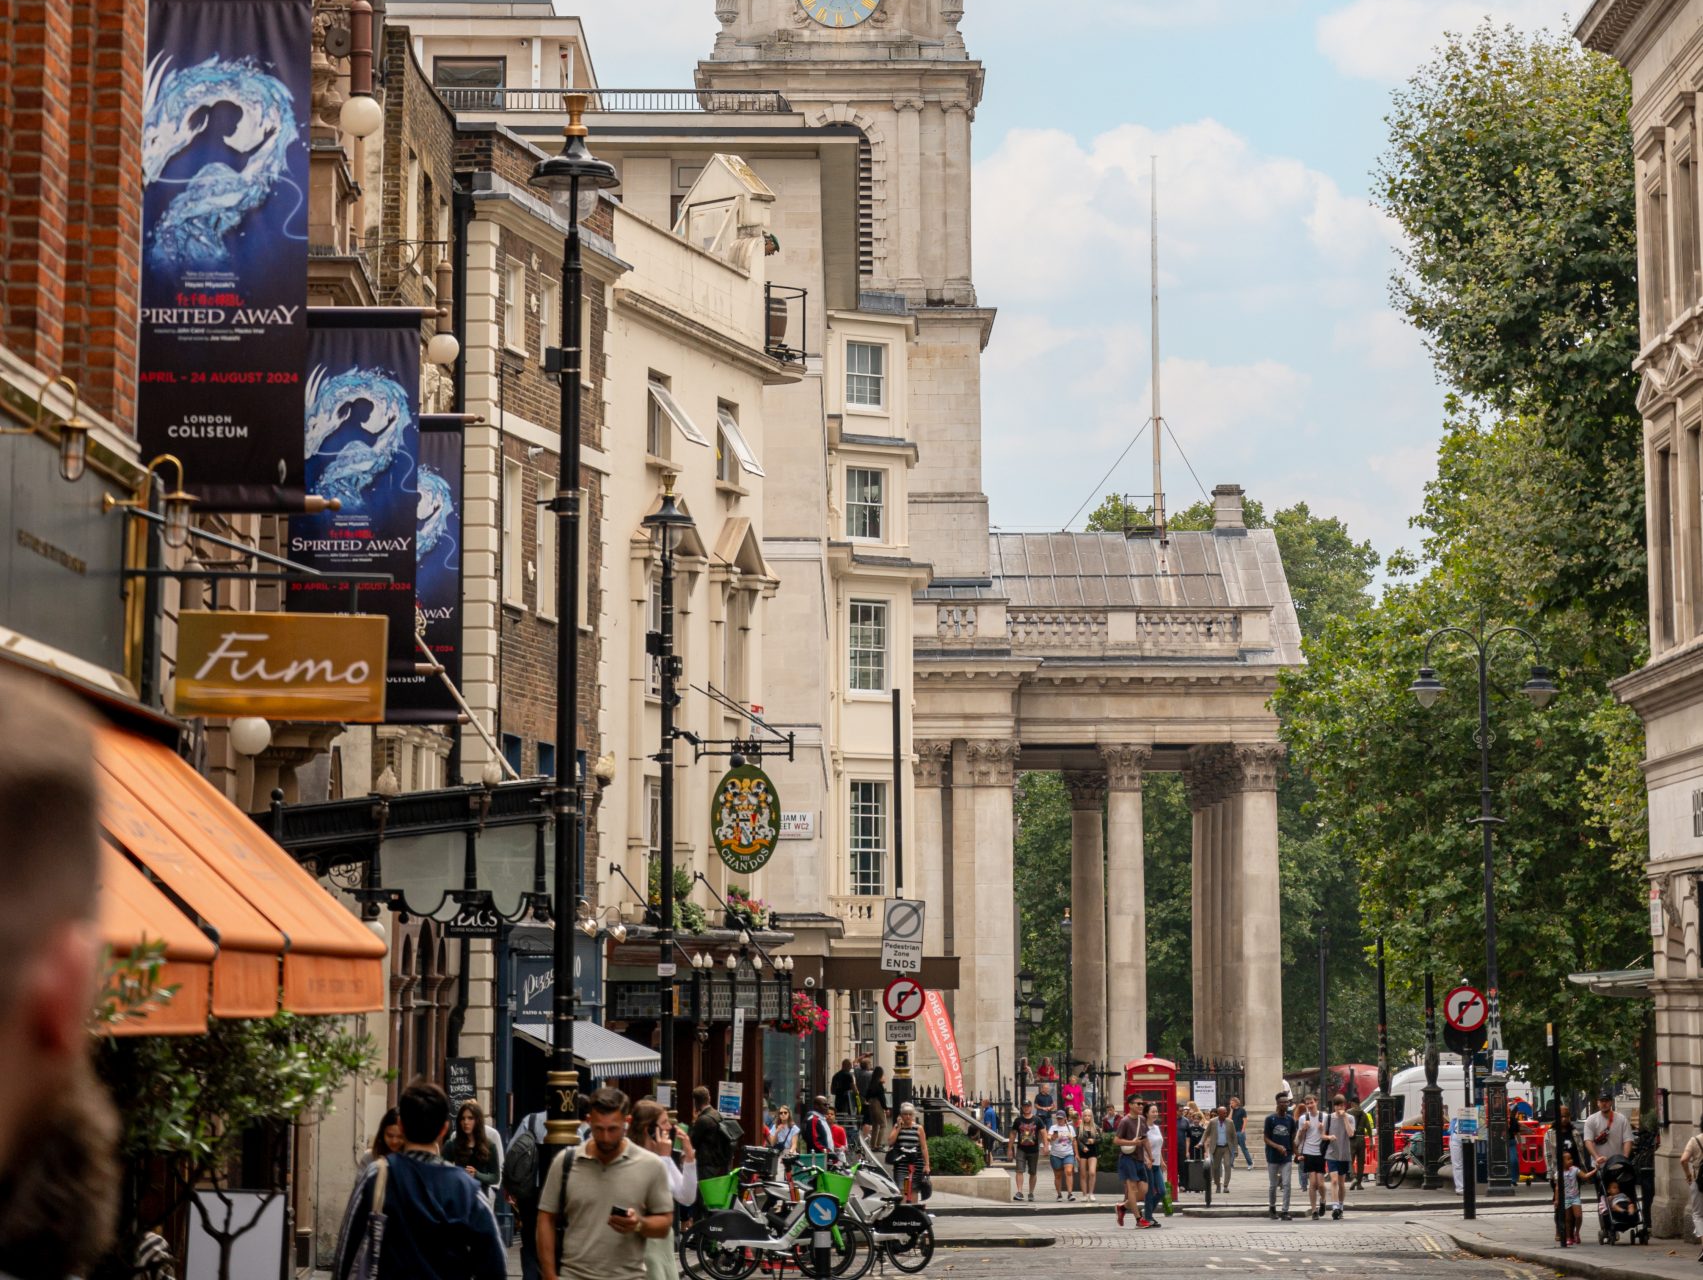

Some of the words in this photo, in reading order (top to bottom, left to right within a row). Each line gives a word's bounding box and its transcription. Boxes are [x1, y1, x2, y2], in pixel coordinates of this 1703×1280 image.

[139, 308, 225, 324] PIRITED
[231, 305, 299, 324] AWAY
[140, 372, 177, 383] APRIL
[190, 372, 207, 383] 24
[209, 372, 264, 383] AUGUST
[266, 372, 299, 383] 2024
[184, 415, 232, 424] LONDON
[168, 426, 248, 438] COLISEUM
[366, 537, 411, 551] AWAY
[304, 583, 329, 591] APRIL
[356, 583, 386, 591] UGUST
[390, 583, 411, 591] 2024
[195, 632, 370, 684] Fumo
[794, 823, 810, 831] WC2
[721, 847, 770, 871] CHANDOS
[885, 942, 920, 951] Pedestrian
[893, 950, 910, 958] Zone
[886, 959, 917, 969] ENDS
